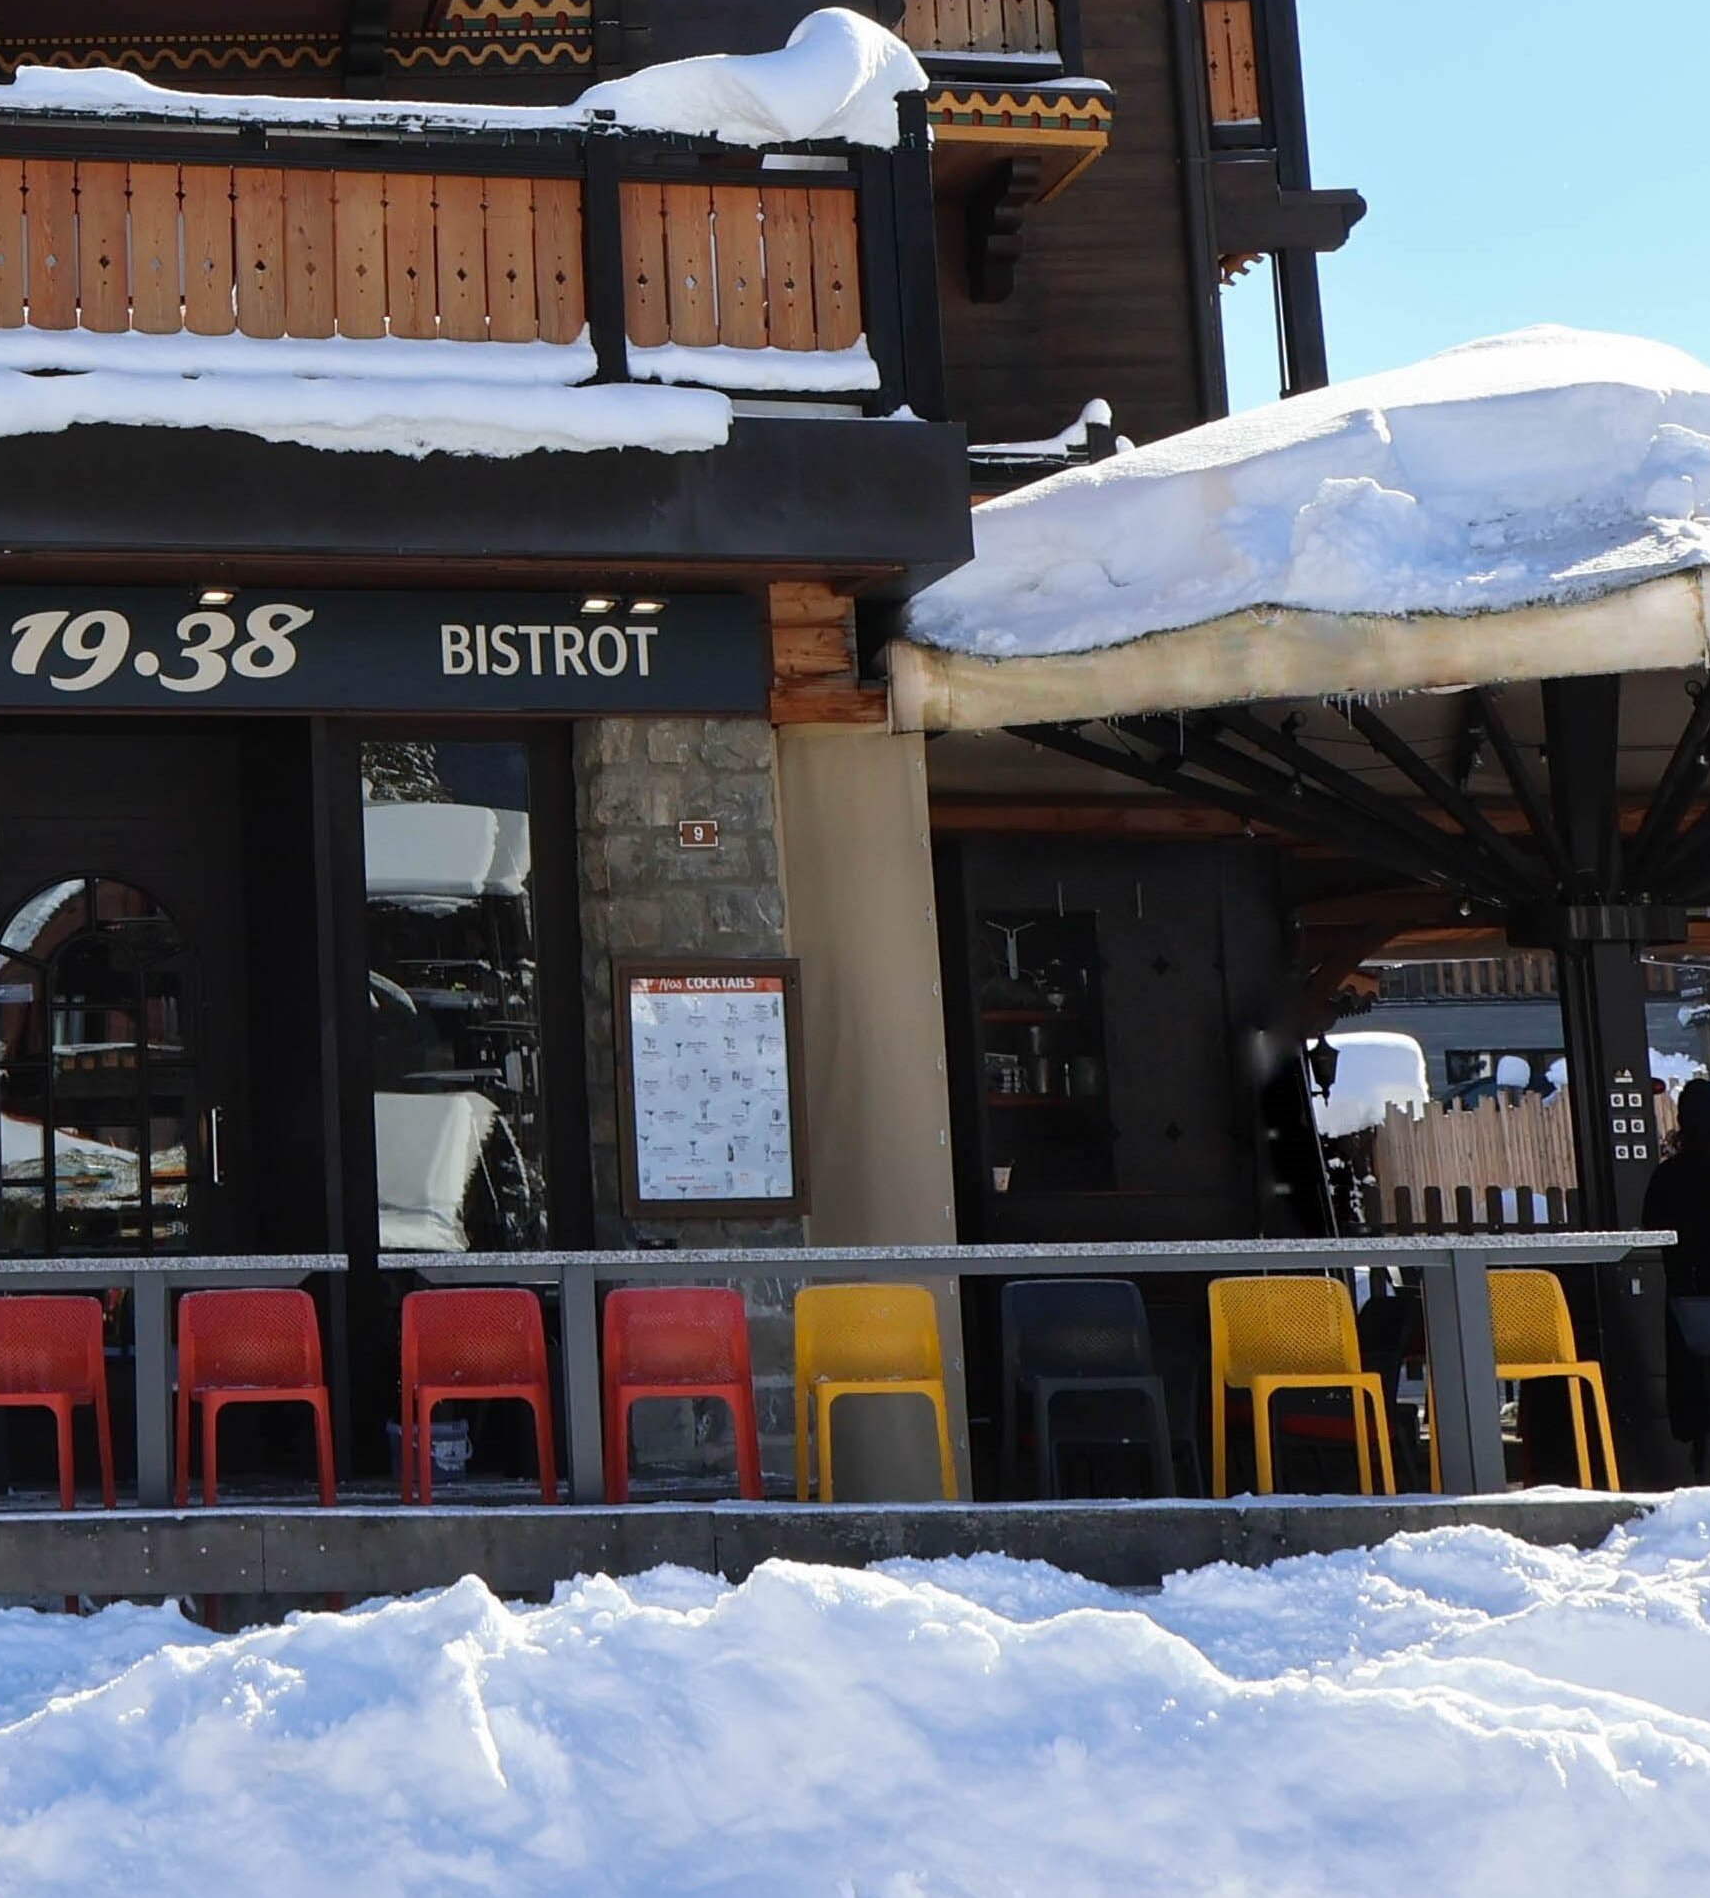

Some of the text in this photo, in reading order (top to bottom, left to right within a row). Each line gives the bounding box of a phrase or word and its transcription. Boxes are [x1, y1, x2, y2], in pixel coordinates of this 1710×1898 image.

[10, 603, 315, 693] 19.38
[440, 623, 660, 678] BISTROT
[693, 825, 704, 842] 9
[659, 977, 756, 991] Nos COCKTAILS
